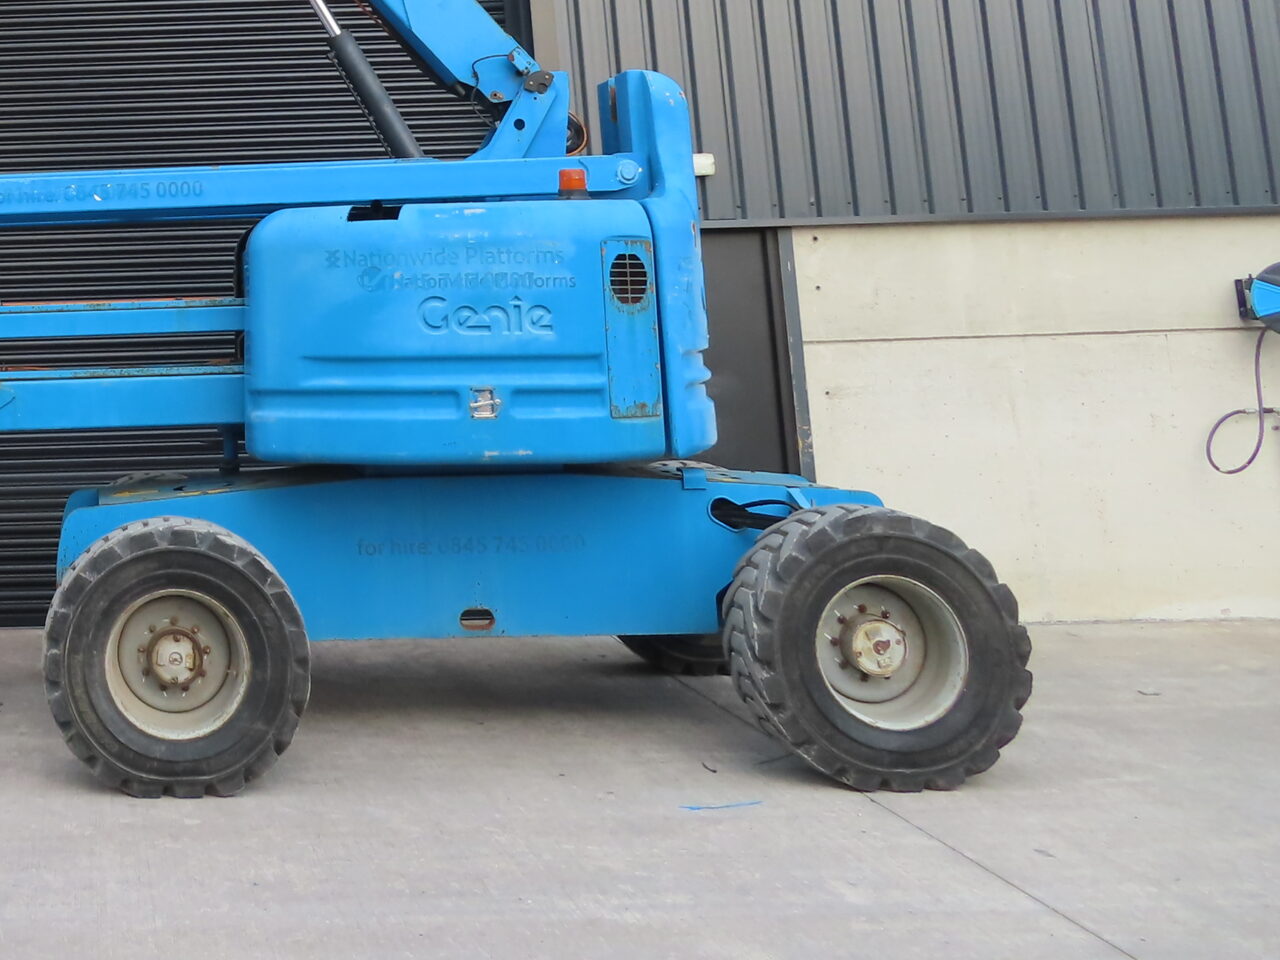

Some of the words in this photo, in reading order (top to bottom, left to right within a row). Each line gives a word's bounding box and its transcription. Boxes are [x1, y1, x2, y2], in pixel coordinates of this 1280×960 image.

[156, 180, 204, 199] 0000
[343, 248, 459, 268] Nationwide
[465, 246, 566, 266] Platforms
[418, 294, 554, 336] Genie
[357, 537, 384, 556] for
